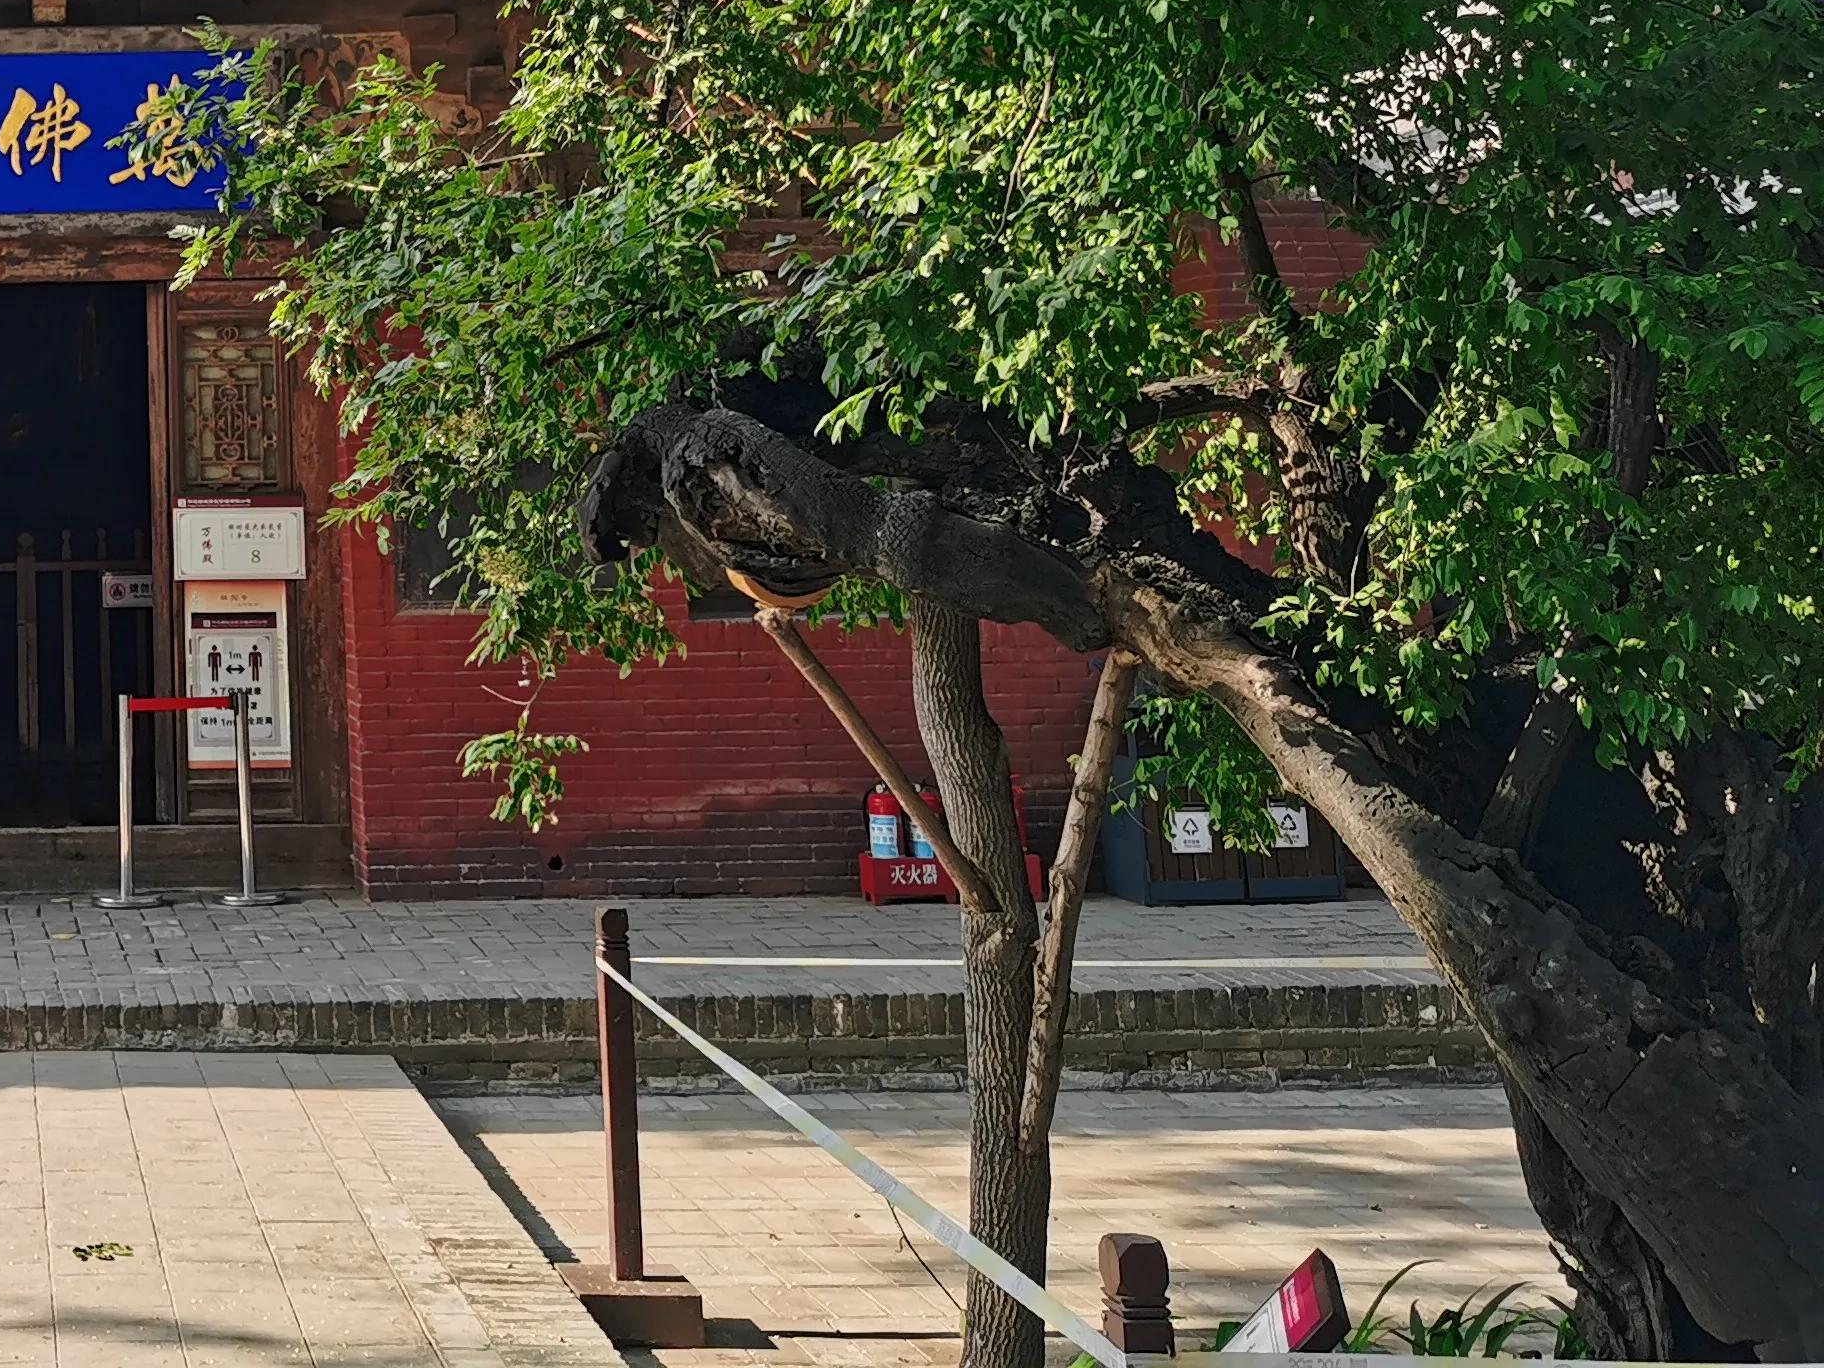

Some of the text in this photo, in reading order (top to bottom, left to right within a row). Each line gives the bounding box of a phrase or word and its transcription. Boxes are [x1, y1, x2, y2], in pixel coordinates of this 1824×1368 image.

[251, 549, 261, 564] 8
[229, 651, 242, 660] 1m
[890, 863, 938, 885] 灭火器
